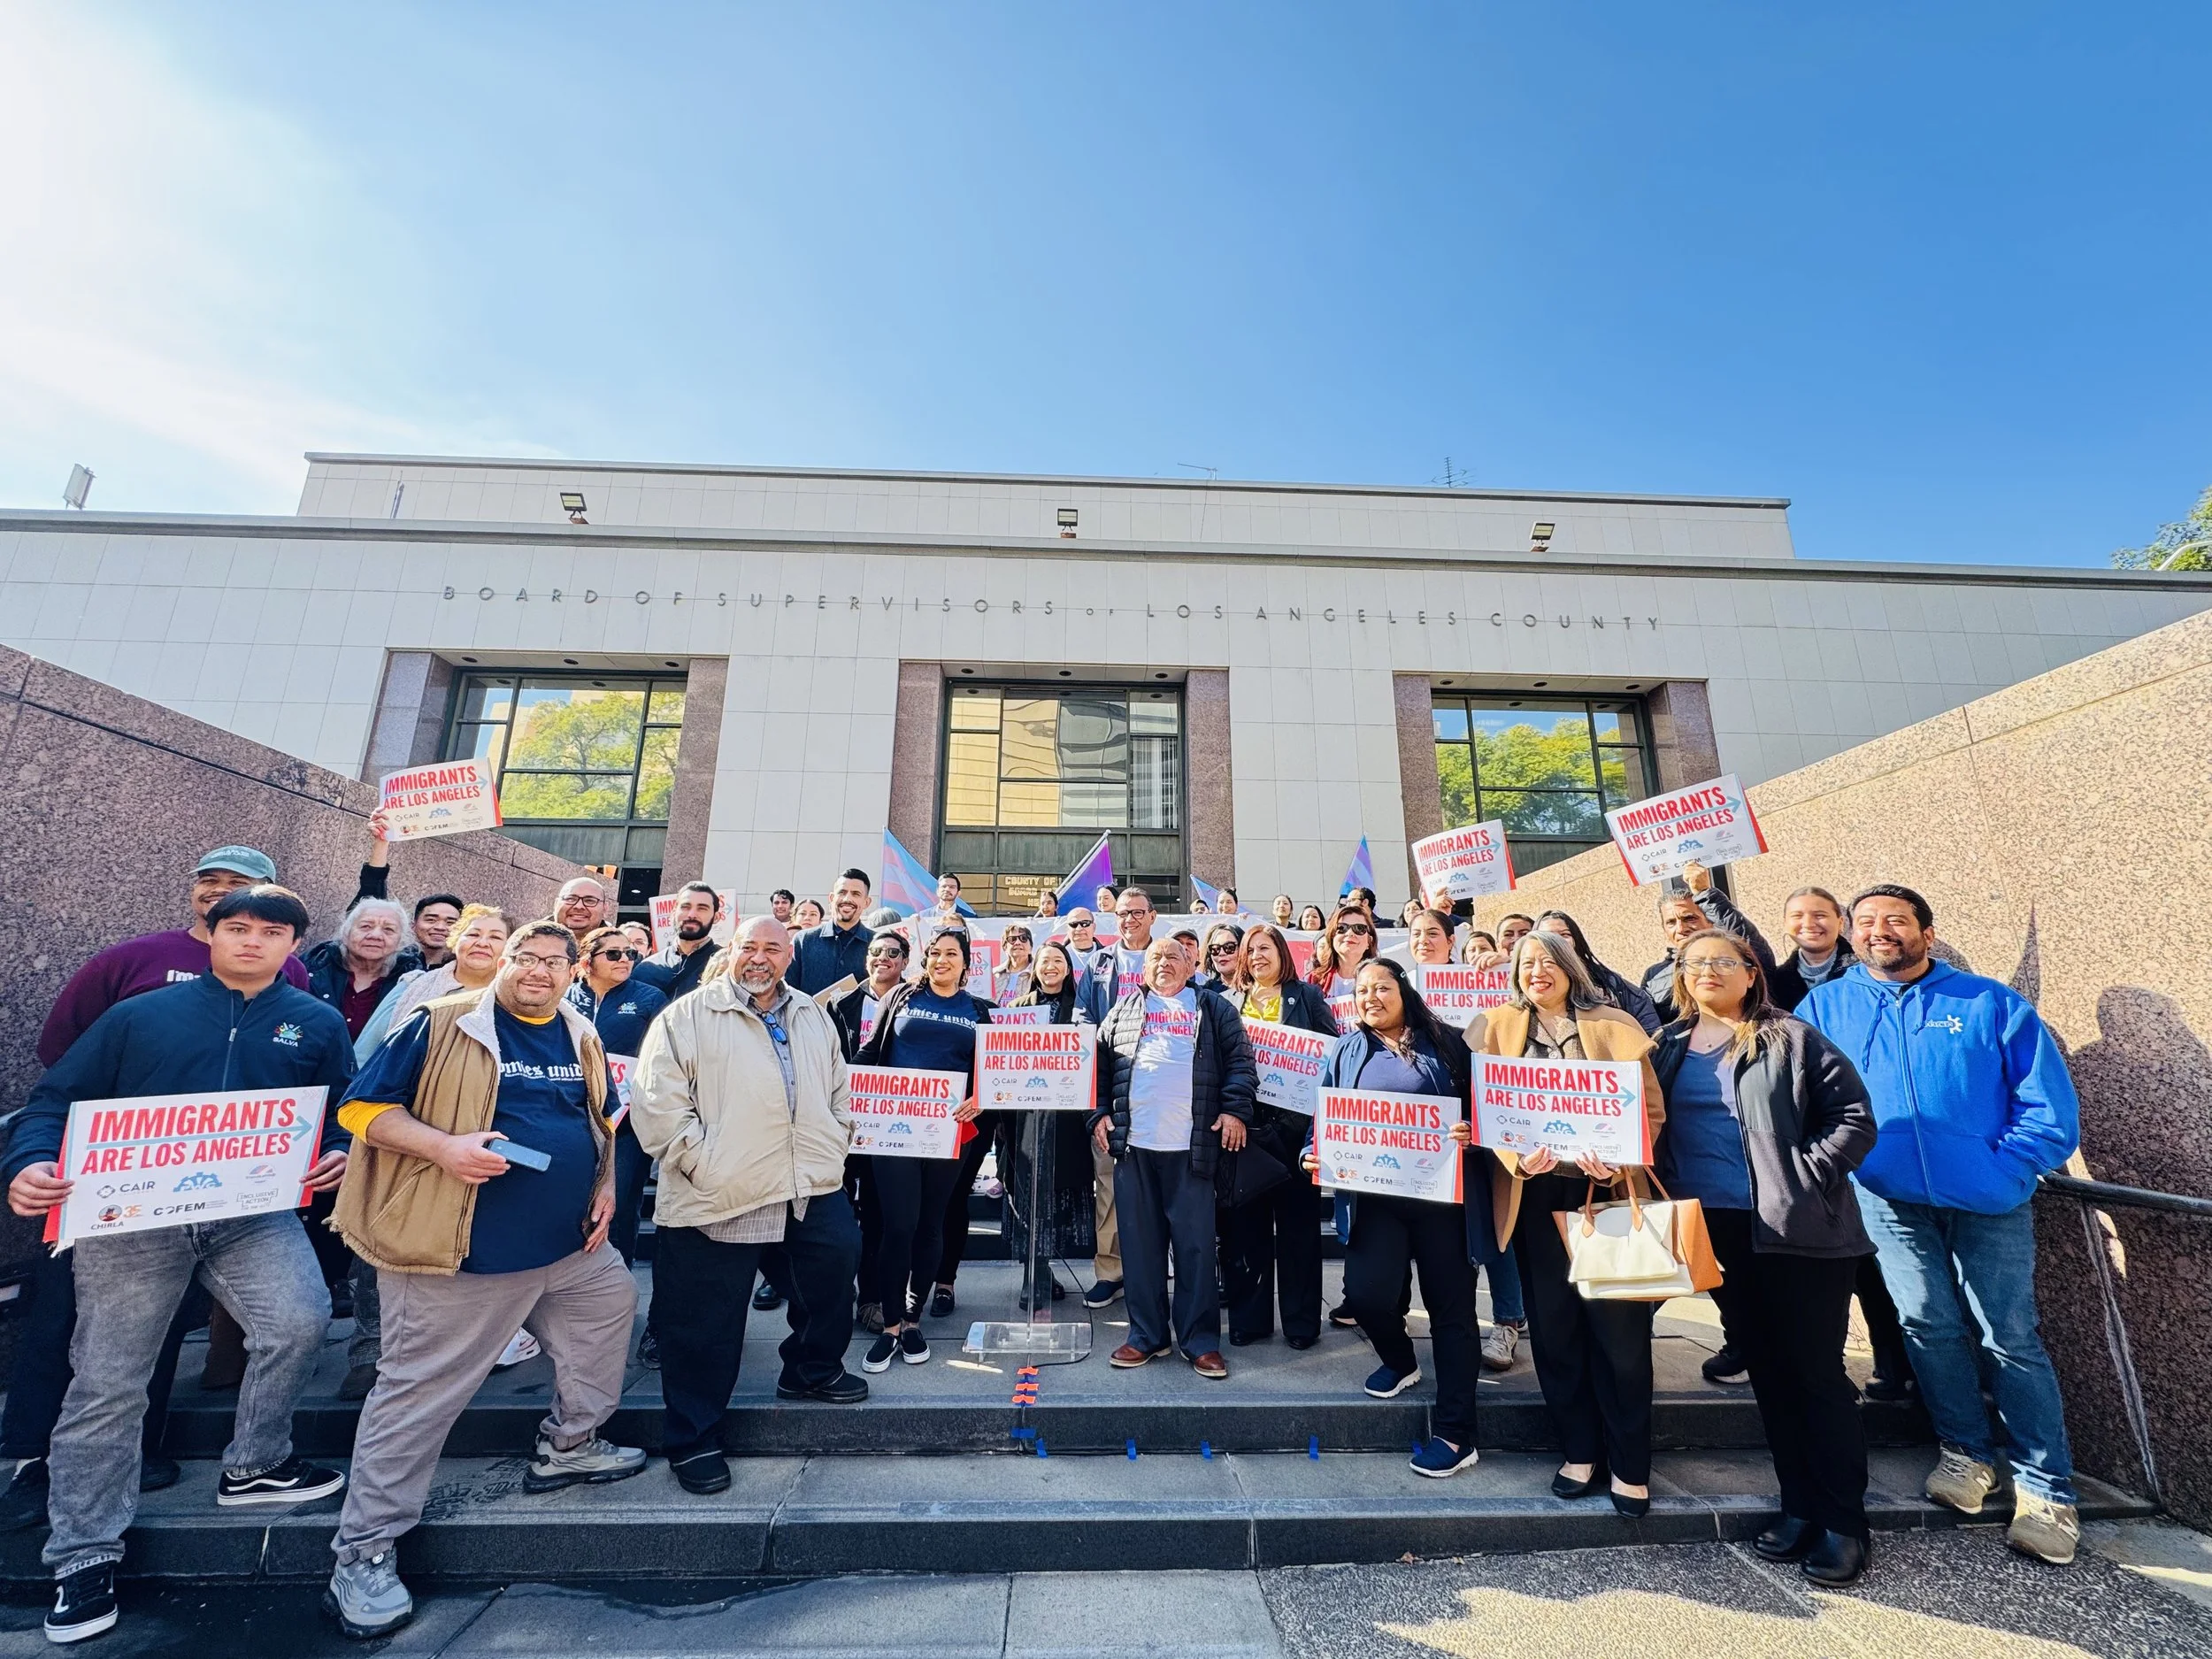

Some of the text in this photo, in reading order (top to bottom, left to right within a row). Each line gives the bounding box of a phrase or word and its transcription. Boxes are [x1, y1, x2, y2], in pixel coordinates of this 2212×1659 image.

[443, 587, 1659, 631] BOARD OF SUPERVISORS OF LOS ANGELES COUNTY
[385, 765, 477, 795] IMMIGRANTS
[384, 786, 480, 810] ARE LOS ANGELES
[1617, 786, 1726, 833] IMMIGRANTS
[1625, 808, 1734, 850] ARE LOS ANGELES
[1418, 829, 1490, 862] IMMIGRANTS
[1650, 849, 1667, 858] CAIR
[1422, 849, 1494, 876] ARE LOS ANGELES
[1005, 876, 1040, 886] COUNTY
[1043, 877, 1056, 886] OF
[657, 917, 671, 928] ARE
[1425, 971, 1509, 990] IMMIGRAN
[1426, 994, 1448, 1007] ARE
[1451, 994, 1473, 1007] LOS
[942, 1014, 977, 1028] unido
[990, 1012, 1037, 1025] GRANTS
[1146, 1010, 1194, 1024] MIGRANT
[1149, 1025, 1164, 1034] LOS
[1167, 1025, 1194, 1035] ANGEL
[273, 1036, 299, 1048] SALVA
[985, 1032, 1080, 1051] IMMIGRANTS
[1246, 1025, 1325, 1059] MMIGRANTS
[500, 1060, 544, 1076] omies
[547, 1063, 584, 1078] unid
[984, 1055, 1080, 1071] ARE LOS ANGELES
[1272, 1054, 1319, 1077] ANGELES
[850, 1072, 950, 1099] IMMIGRANTS
[1485, 1063, 1619, 1094] IMMIGRANTS
[872, 1098, 895, 1115] LOS
[896, 1100, 948, 1118] ANGELES
[1326, 1095, 1440, 1129] IMMIGRANTS
[1485, 1089, 1622, 1117] ARE LOS ANGELES
[88, 1098, 296, 1143] IMMIGRANTS
[1509, 1118, 1531, 1126] CAIR
[1325, 1125, 1441, 1153] ARE LOS ANGELES
[81, 1133, 292, 1175] ARE LOS ANGELES
[119, 1180, 156, 1193] CAIR
[90, 1221, 125, 1231] CHIRLA
